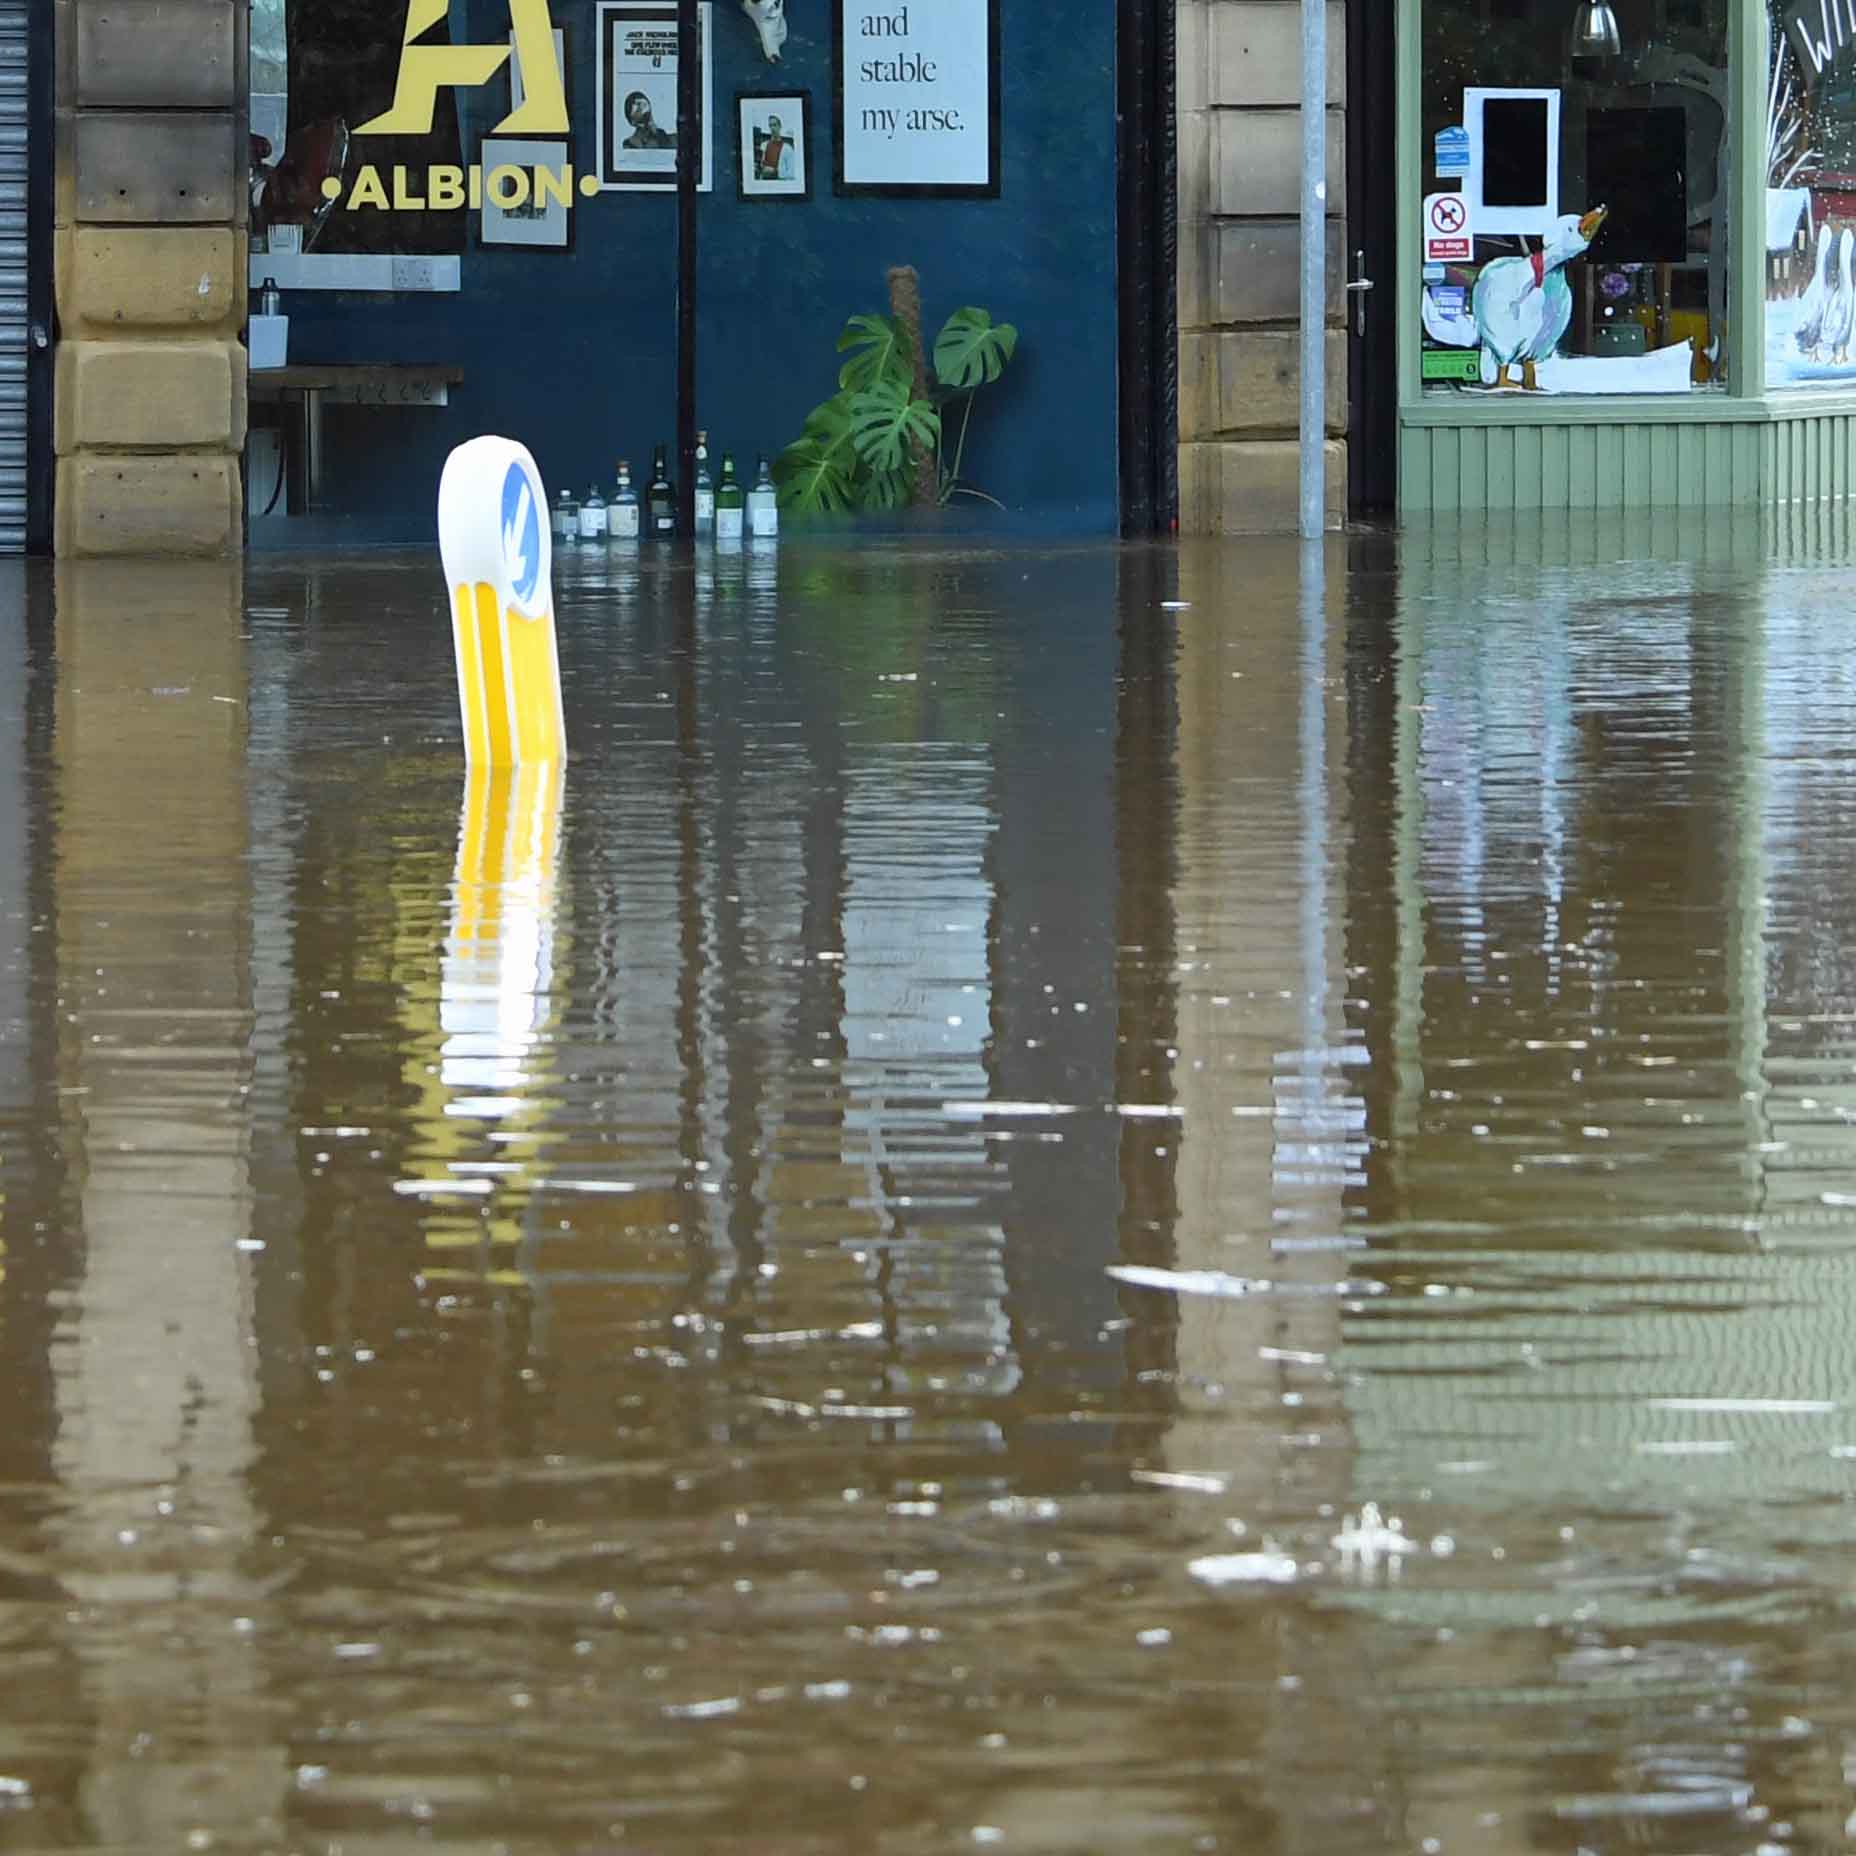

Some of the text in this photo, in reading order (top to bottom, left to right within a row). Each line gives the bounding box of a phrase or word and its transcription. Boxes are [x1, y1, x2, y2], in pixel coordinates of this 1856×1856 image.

[861, 5, 908, 36] and
[861, 52, 937, 83] stable
[861, 109, 965, 140] my arse.
[345, 163, 573, 210] ALBION
